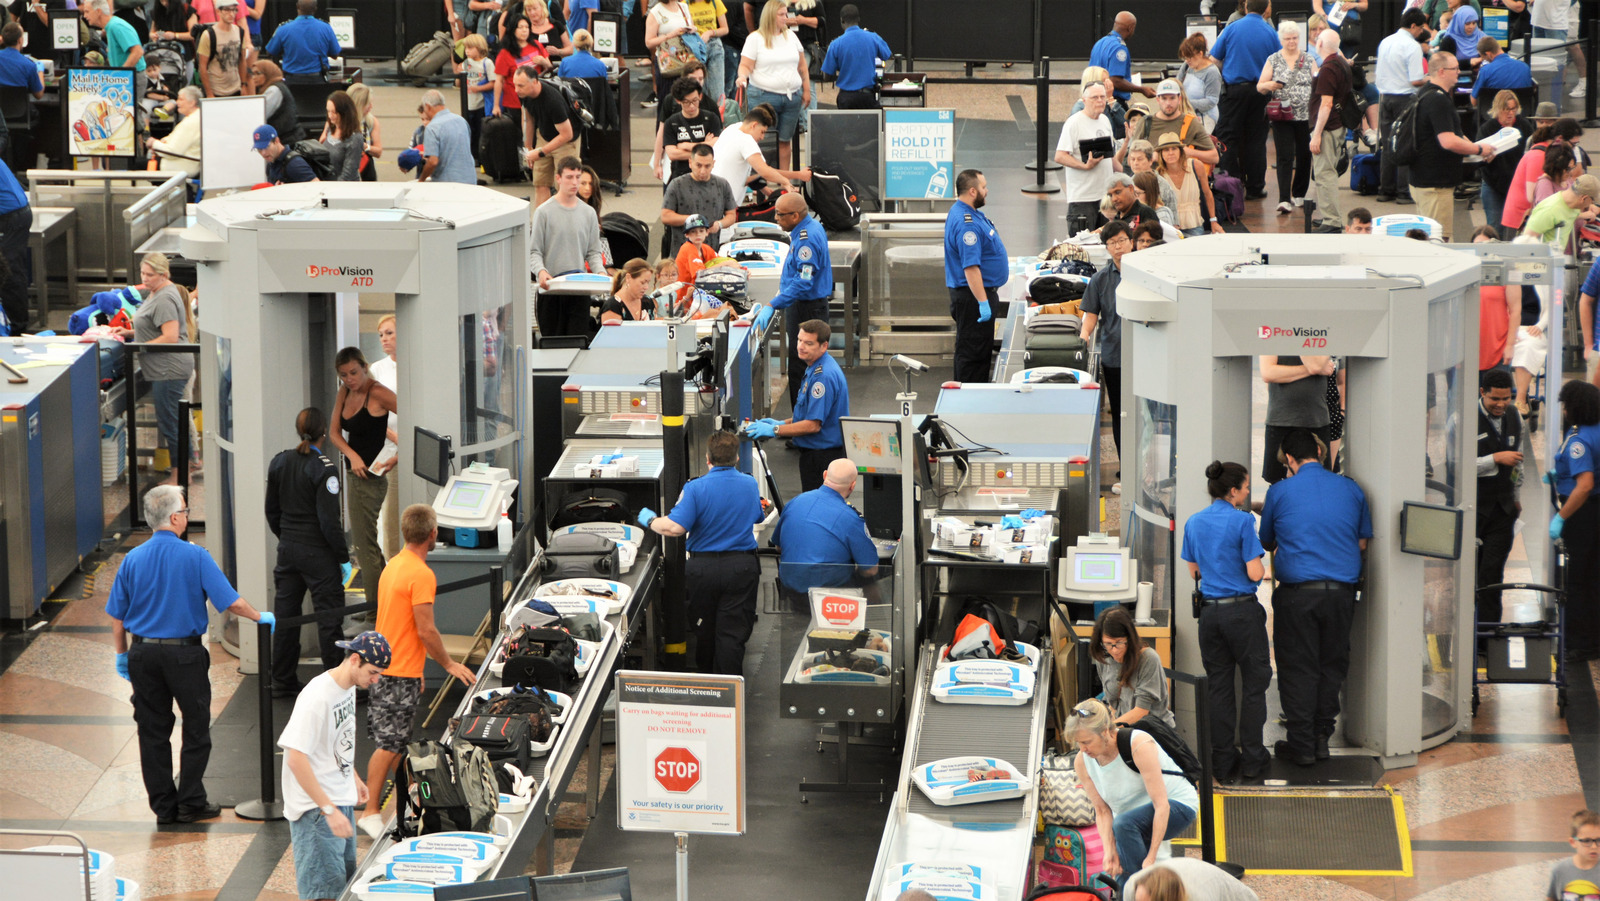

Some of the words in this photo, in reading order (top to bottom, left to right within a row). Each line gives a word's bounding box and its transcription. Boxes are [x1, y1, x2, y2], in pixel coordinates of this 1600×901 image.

[72, 74, 90, 82] Mail
[891, 125, 932, 135] EMPTY
[936, 125, 946, 135] IT
[892, 137, 930, 147] HOLD
[934, 137, 946, 147] IT
[892, 149, 932, 158] REFILL
[936, 149, 946, 158] IT
[321, 266, 373, 276] ProVision
[351, 277, 373, 286] ATD
[669, 326, 674, 339] 5
[1274, 327, 1327, 336] ProVision
[1302, 338, 1327, 348] ATD
[903, 402, 909, 416] 6
[826, 603, 855, 613] STOP
[690, 689, 721, 697] Screening
[666, 709, 688, 717] waiting
[657, 761, 697, 778] STOP
